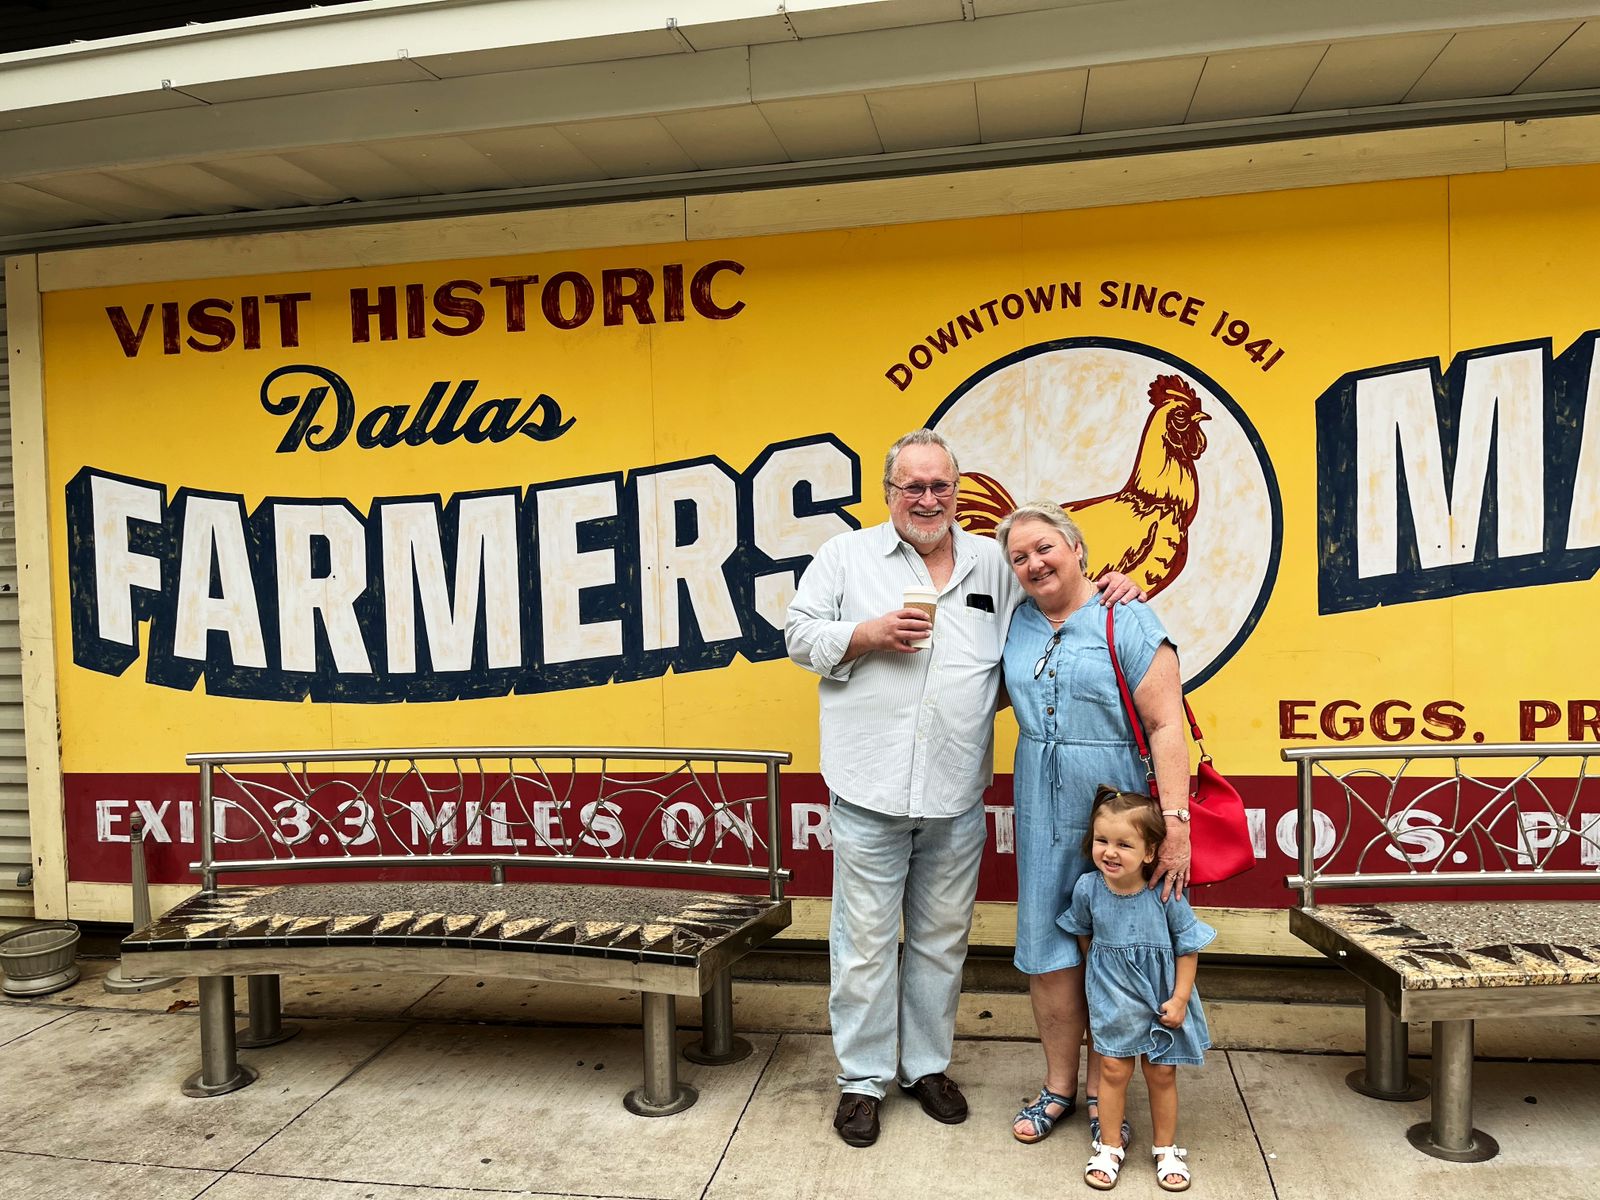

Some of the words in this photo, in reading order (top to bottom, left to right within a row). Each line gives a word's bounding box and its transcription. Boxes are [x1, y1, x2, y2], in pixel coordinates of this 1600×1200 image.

[106, 291, 311, 357] VISIT
[350, 259, 746, 343] HISTORIC
[885, 281, 1081, 392] DOWNTOWN
[1099, 280, 1205, 327] SINCE
[1210, 310, 1285, 372] 1941
[260, 364, 577, 453] Dallas
[66, 433, 861, 703] FARMERS
[1279, 700, 1484, 743] EGGS.
[272, 799, 377, 846] 3.3
[410, 800, 623, 848] MILES
[661, 801, 754, 851] ON
